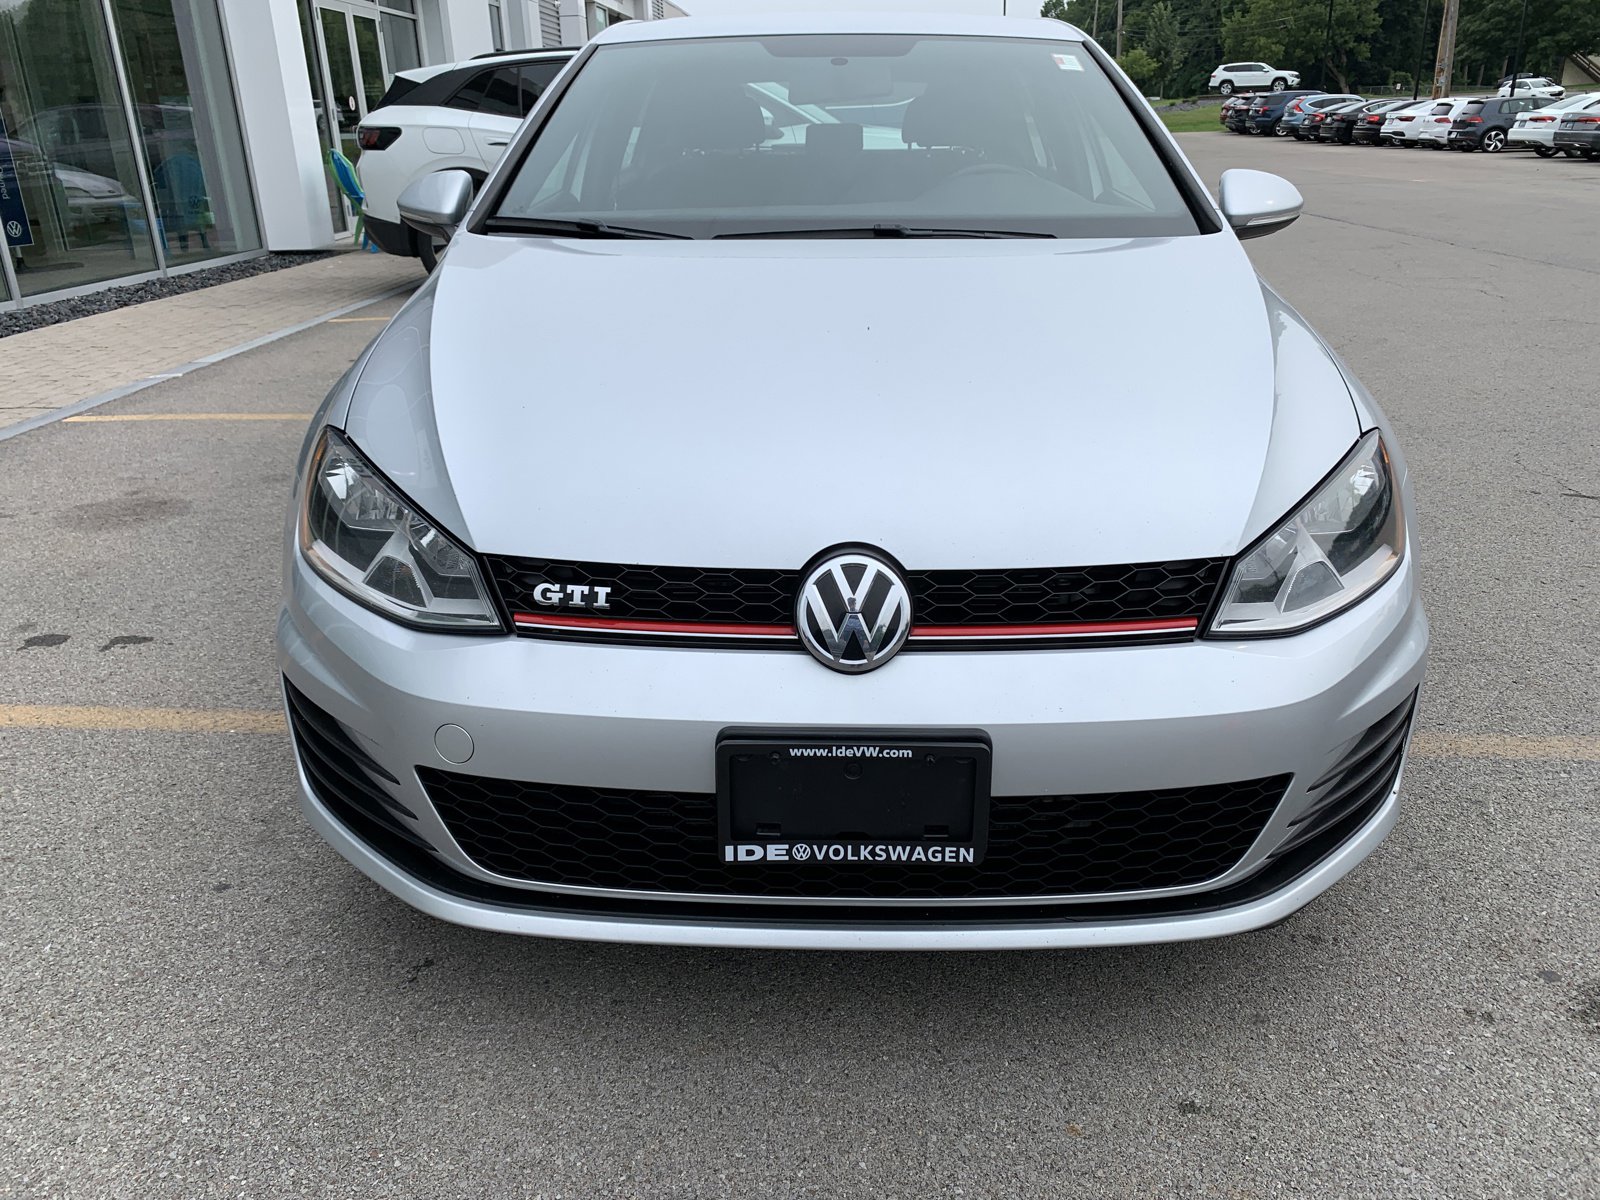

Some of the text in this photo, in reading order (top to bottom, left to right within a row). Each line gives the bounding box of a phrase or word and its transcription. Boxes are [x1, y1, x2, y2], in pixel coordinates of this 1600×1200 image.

[533, 582, 611, 609] GTI
[798, 555, 910, 672] VW
[789, 746, 912, 758] www.IdeVW.com
[725, 844, 789, 862] IDE
[813, 845, 974, 863] VOLKSWAGEN
